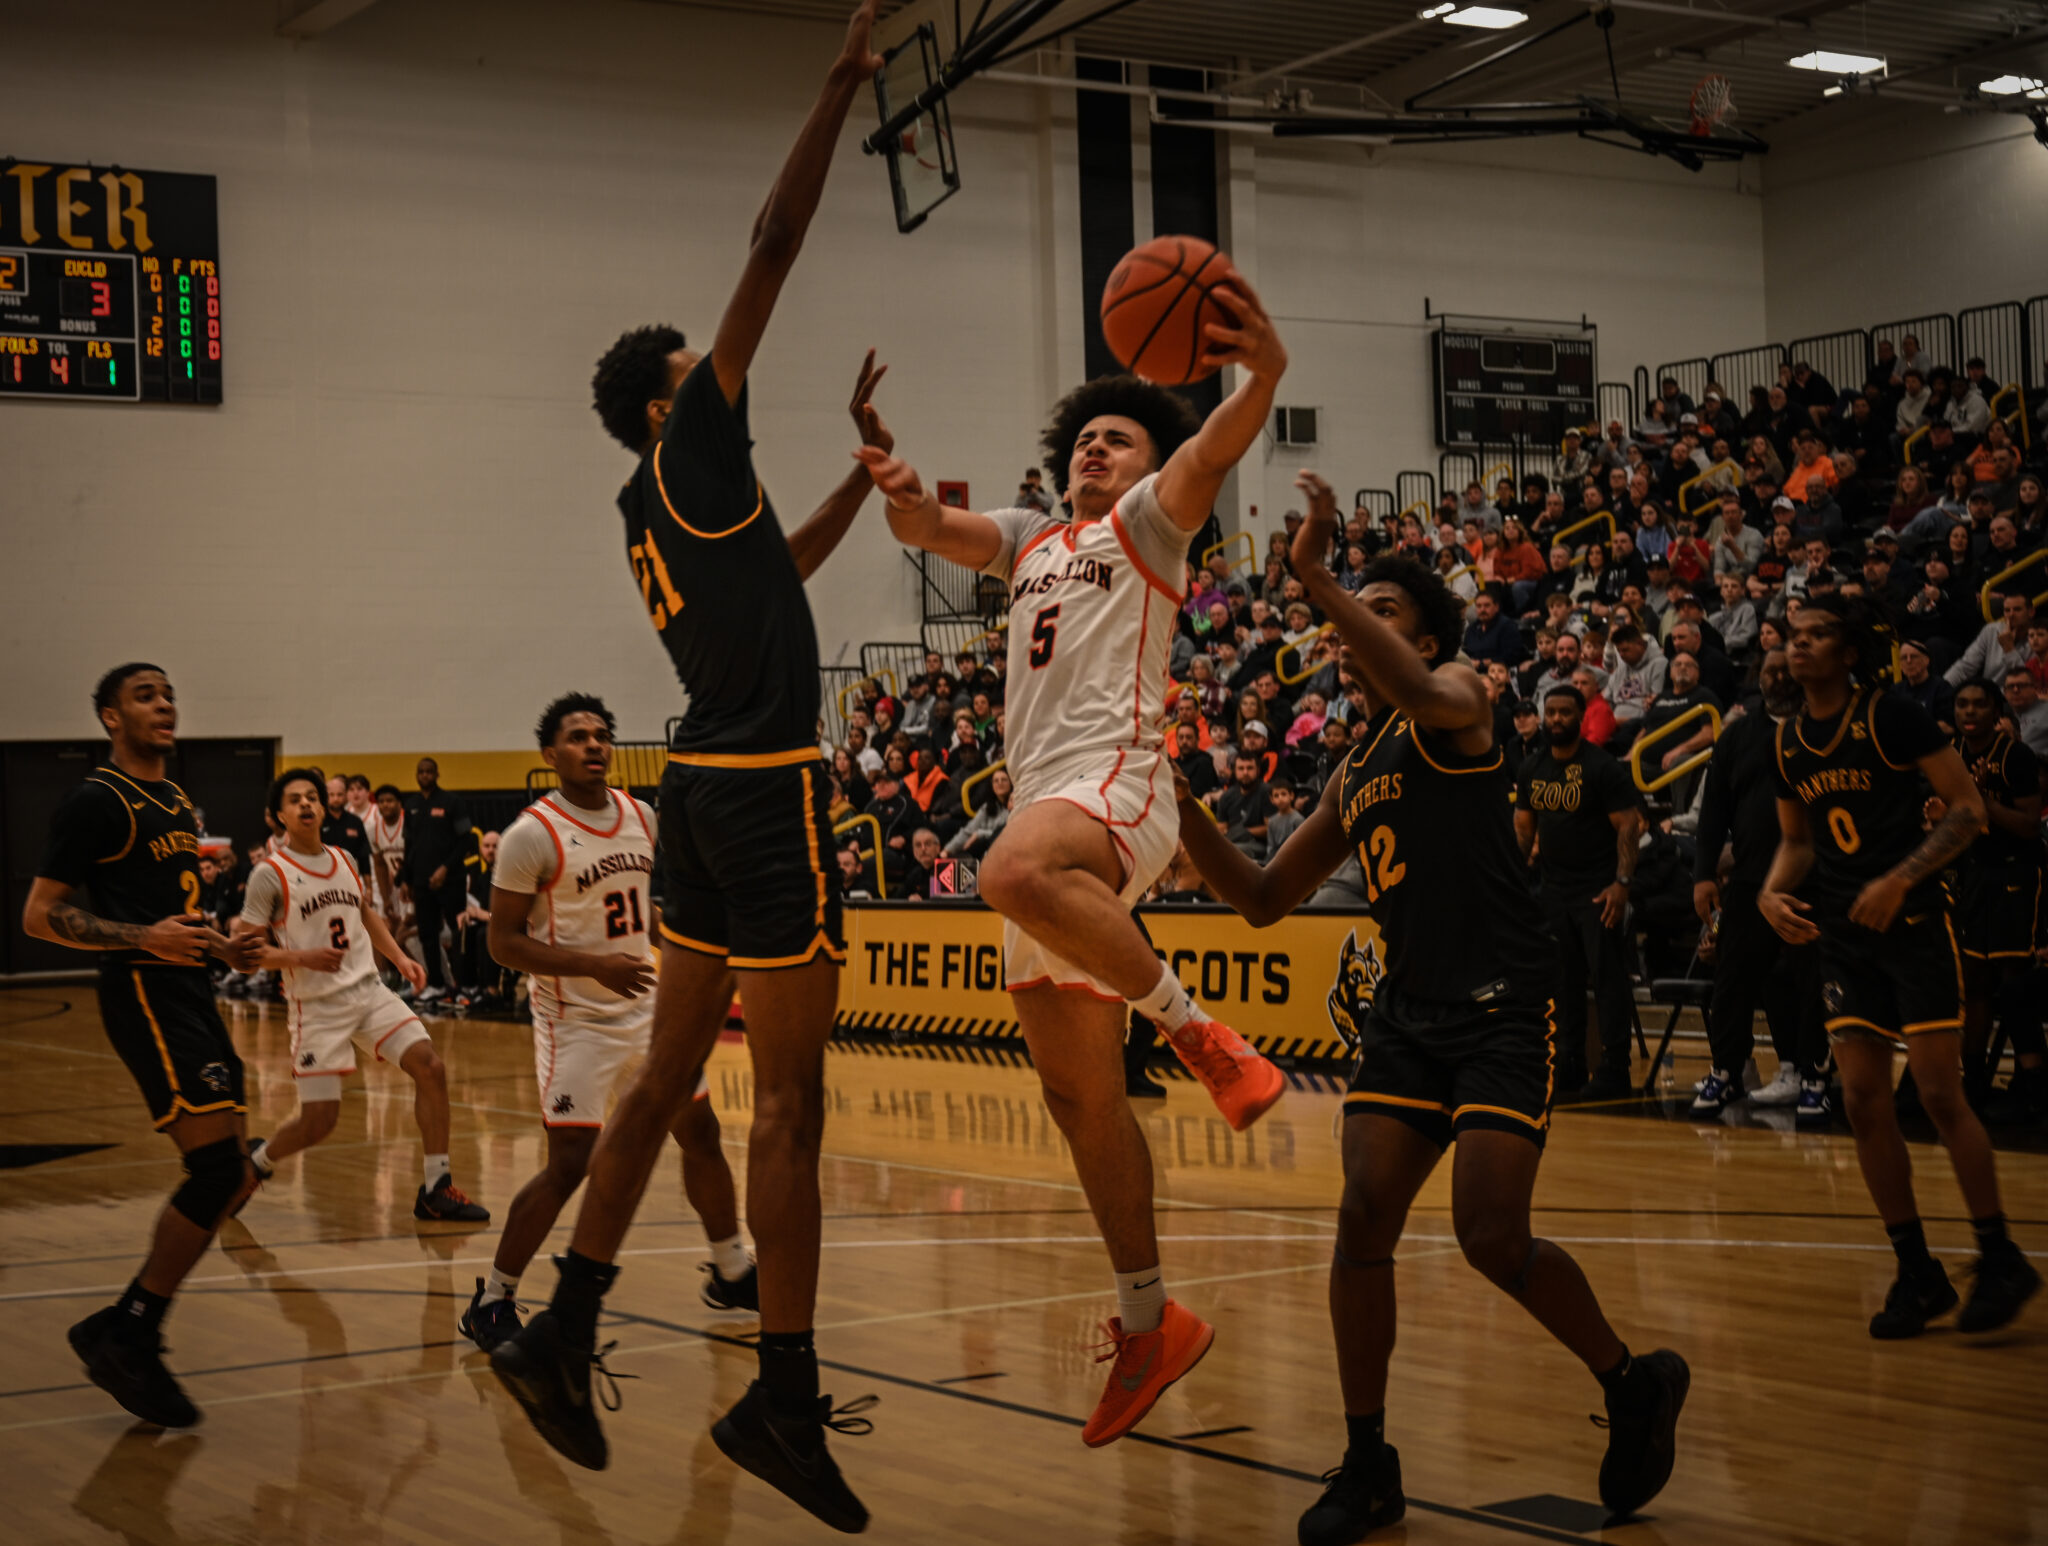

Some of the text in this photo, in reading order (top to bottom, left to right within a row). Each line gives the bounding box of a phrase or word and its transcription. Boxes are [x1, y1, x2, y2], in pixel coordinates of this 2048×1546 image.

[0, 163, 154, 253] TER
[64, 258, 107, 279] EUCLID
[173, 257, 182, 275] F
[190, 258, 216, 277] PTS
[90, 281, 111, 317] 3
[150, 272, 219, 297] 0 0 0
[179, 295, 191, 316] 0
[207, 297, 220, 318] 0
[60, 318, 98, 334] BONUS
[151, 315, 220, 339] 2 0 0
[47, 341, 70, 355] TOL
[180, 338, 192, 358] 0
[208, 339, 221, 361] 0
[13, 354, 117, 387] 1 4 1
[186, 360, 193, 379] 1
[628, 527, 686, 632] 21
[1029, 602, 1061, 671] 5
[1529, 778, 1581, 814] ZOO
[1826, 805, 1862, 856] 0
[1358, 824, 1407, 904] 12
[178, 869, 204, 919] 2
[603, 886, 645, 940] 21
[329, 917, 350, 951] 2
[865, 942, 930, 987] THE
